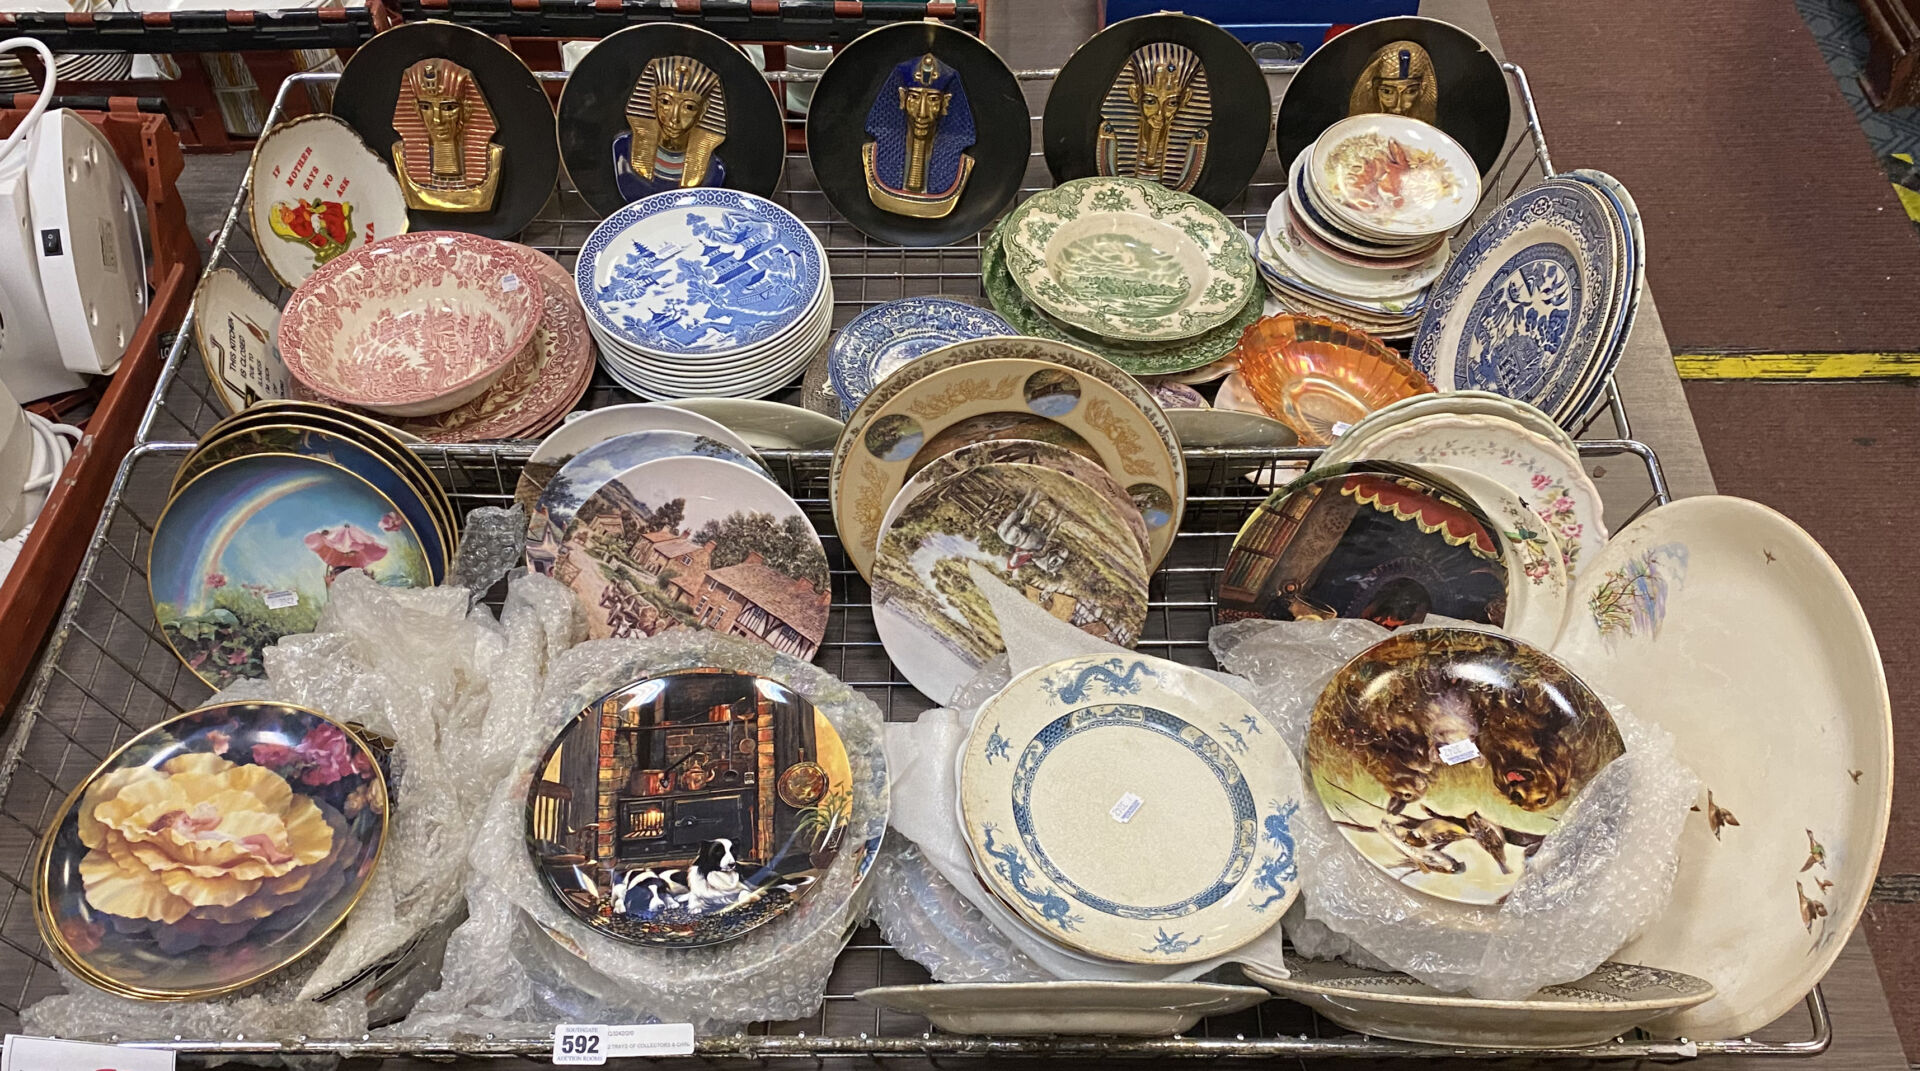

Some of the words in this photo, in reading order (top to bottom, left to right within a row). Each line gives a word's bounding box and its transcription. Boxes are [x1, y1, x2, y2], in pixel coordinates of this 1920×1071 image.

[273, 165, 280, 178] IF
[286, 147, 312, 187] MOTHER
[303, 166, 319, 190] SAYS
[322, 174, 333, 188] NO
[336, 177, 350, 197] ASK
[228, 316, 237, 351] KITCHEN
[239, 335, 247, 367] CLOSED
[249, 352, 254, 361] TO
[229, 351, 237, 372] THIS
[240, 368, 247, 379] IS
[562, 1035, 600, 1053] 592
